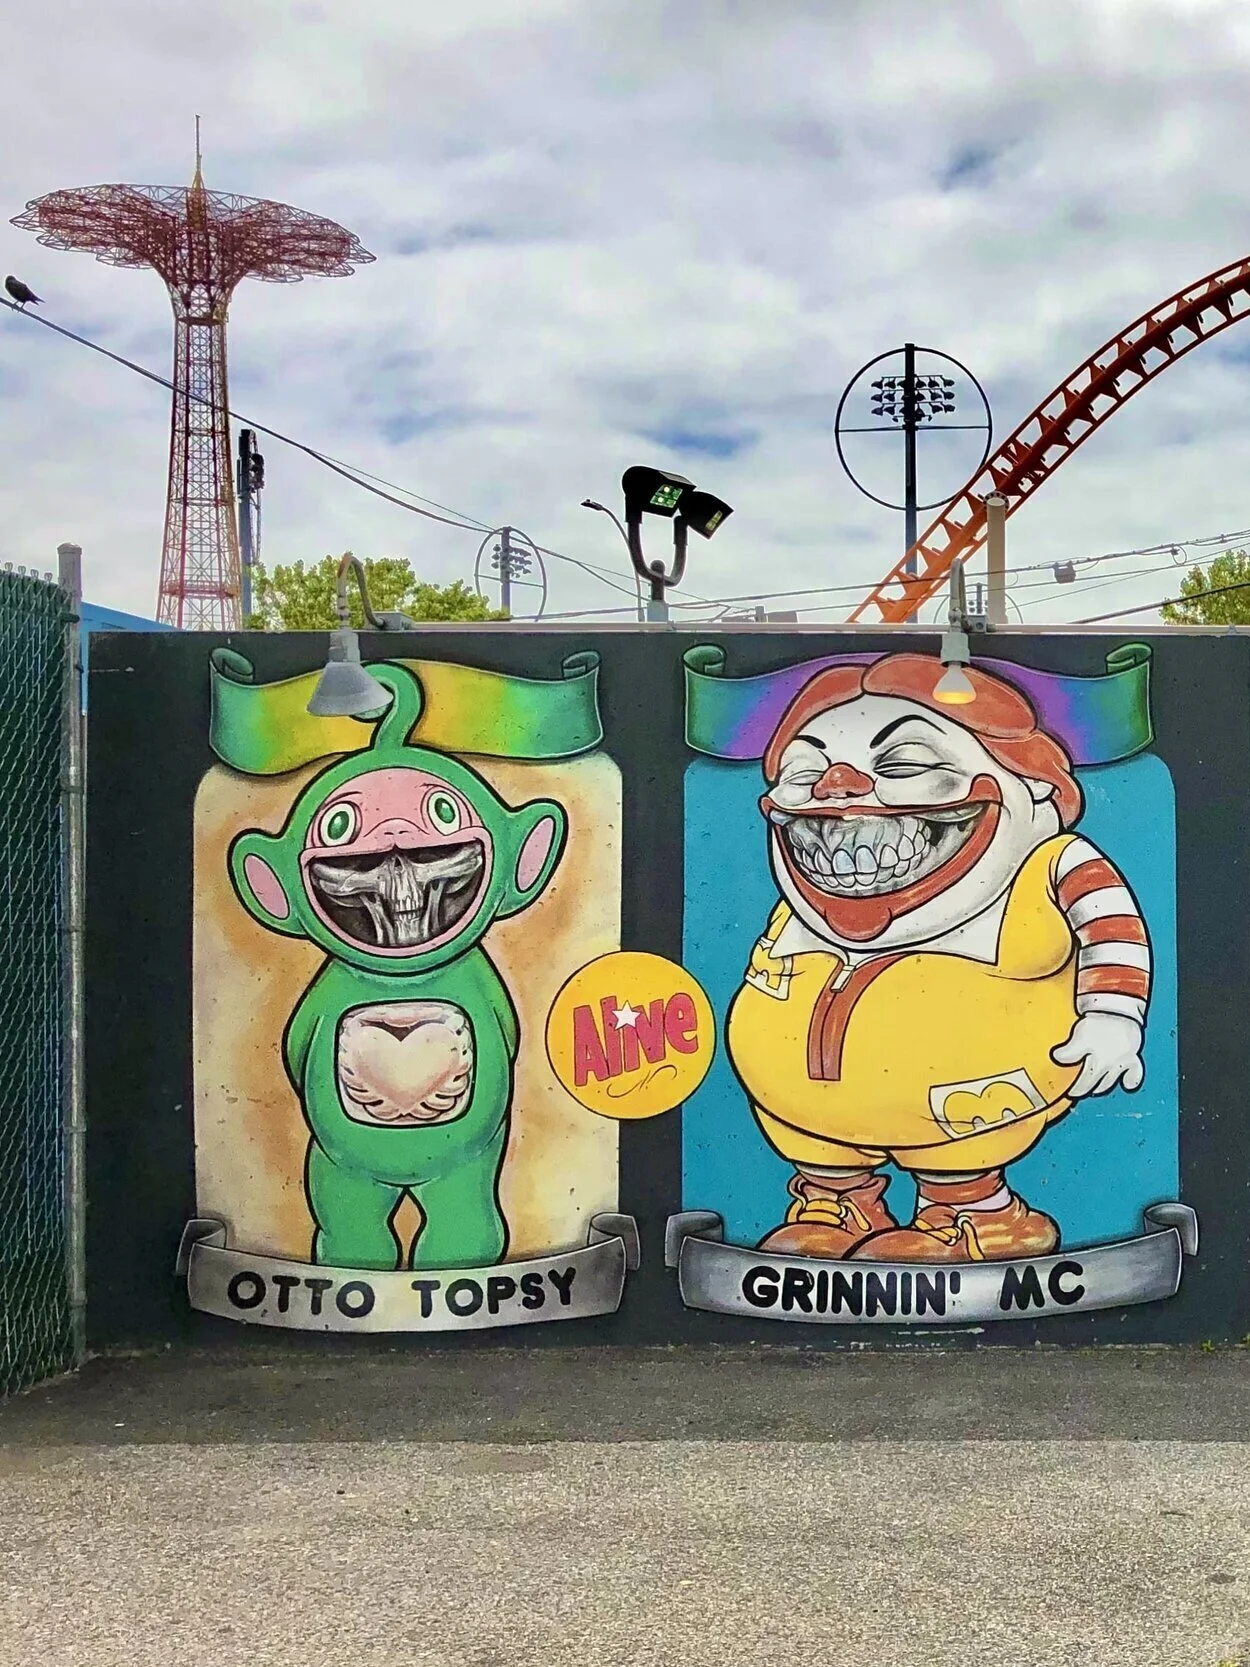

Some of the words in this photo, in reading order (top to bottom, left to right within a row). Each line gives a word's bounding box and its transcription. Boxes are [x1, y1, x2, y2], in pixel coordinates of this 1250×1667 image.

[227, 1271, 375, 1318] OTTO
[411, 1266, 577, 1318] TOPSY
[741, 1265, 961, 1317] GRINNIN'
[999, 1260, 1086, 1311] MC
